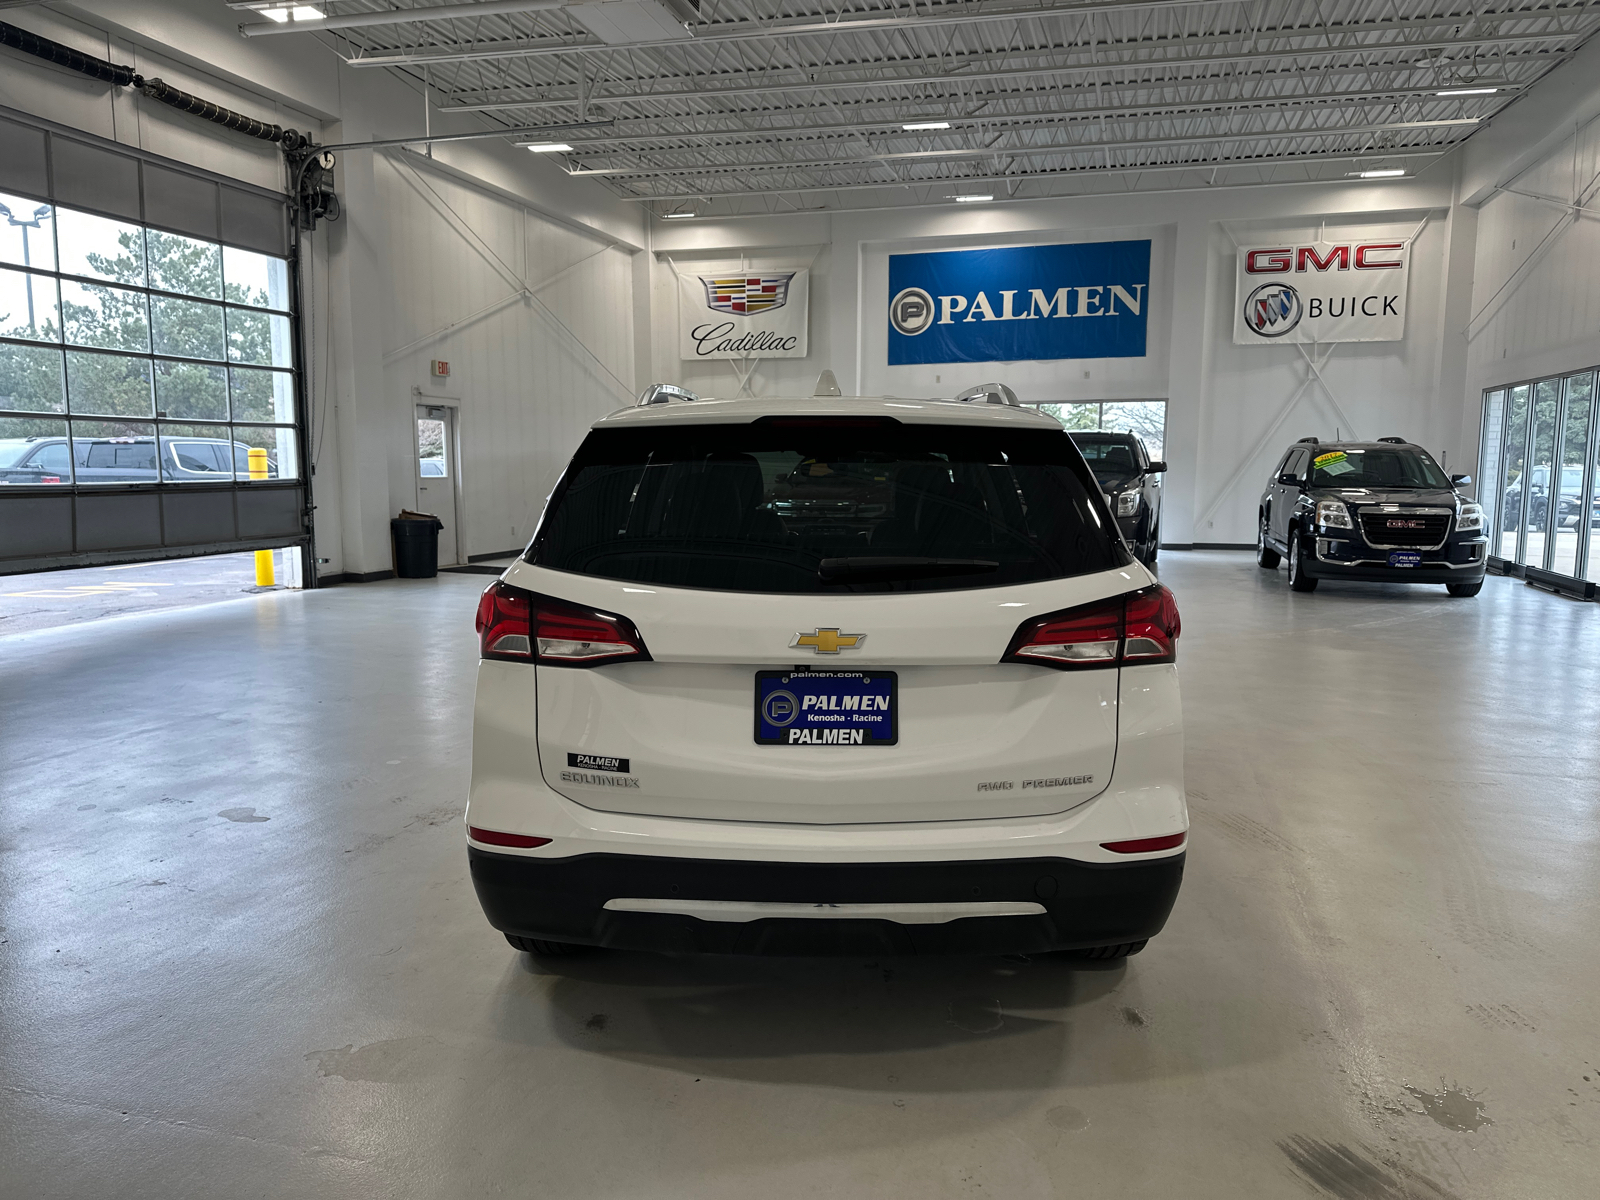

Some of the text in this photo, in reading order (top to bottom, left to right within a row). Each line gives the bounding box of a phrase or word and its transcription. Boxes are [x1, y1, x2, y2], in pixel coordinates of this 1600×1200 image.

[1245, 242, 1404, 275] GMC
[937, 284, 1146, 325] PALMEN
[1309, 295, 1399, 318] BUICK
[691, 322, 797, 356] Cadillac
[437, 360, 448, 375] EXIT
[1386, 519, 1425, 528] GMC
[790, 671, 863, 679] palmen.com
[802, 695, 890, 711] PALMEN
[807, 714, 845, 722] Kenosha
[852, 714, 883, 722] Racine
[788, 728, 864, 744] PALMEN
[577, 755, 619, 767] PALMEN
[560, 770, 640, 788] EQUINOX
[977, 774, 1094, 792] AWD PREMIER
